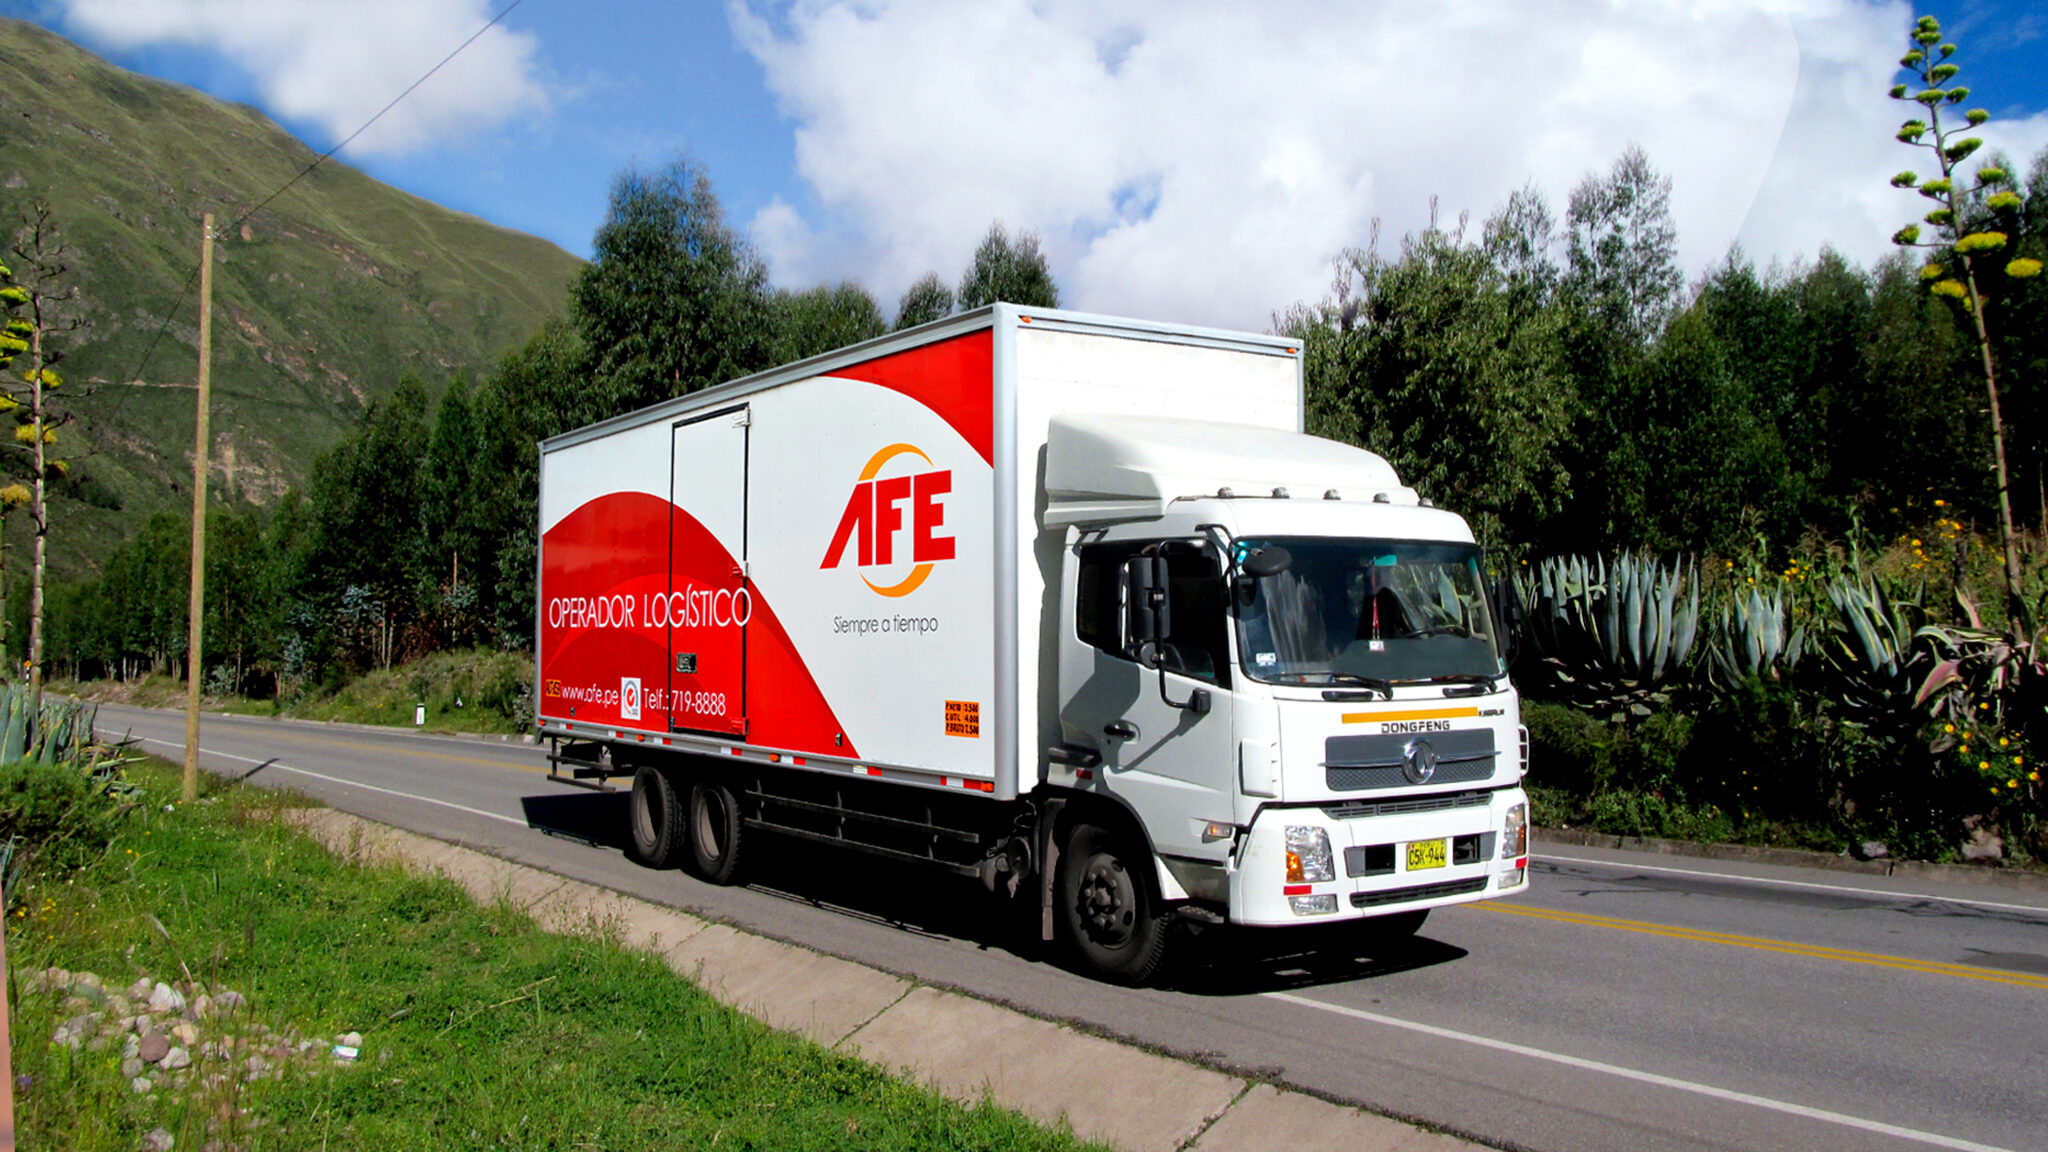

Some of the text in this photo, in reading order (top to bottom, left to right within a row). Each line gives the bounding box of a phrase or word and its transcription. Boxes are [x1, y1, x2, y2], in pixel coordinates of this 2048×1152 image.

[819, 469, 955, 569] AFE
[549, 584, 752, 628] OPERADOR LOGÍSTICO
[833, 614, 938, 636] Siempre a tiempo
[562, 683, 619, 709] www.afe.pe
[671, 690, 726, 717] 719-8888
[1381, 720, 1450, 734] DONGFENG
